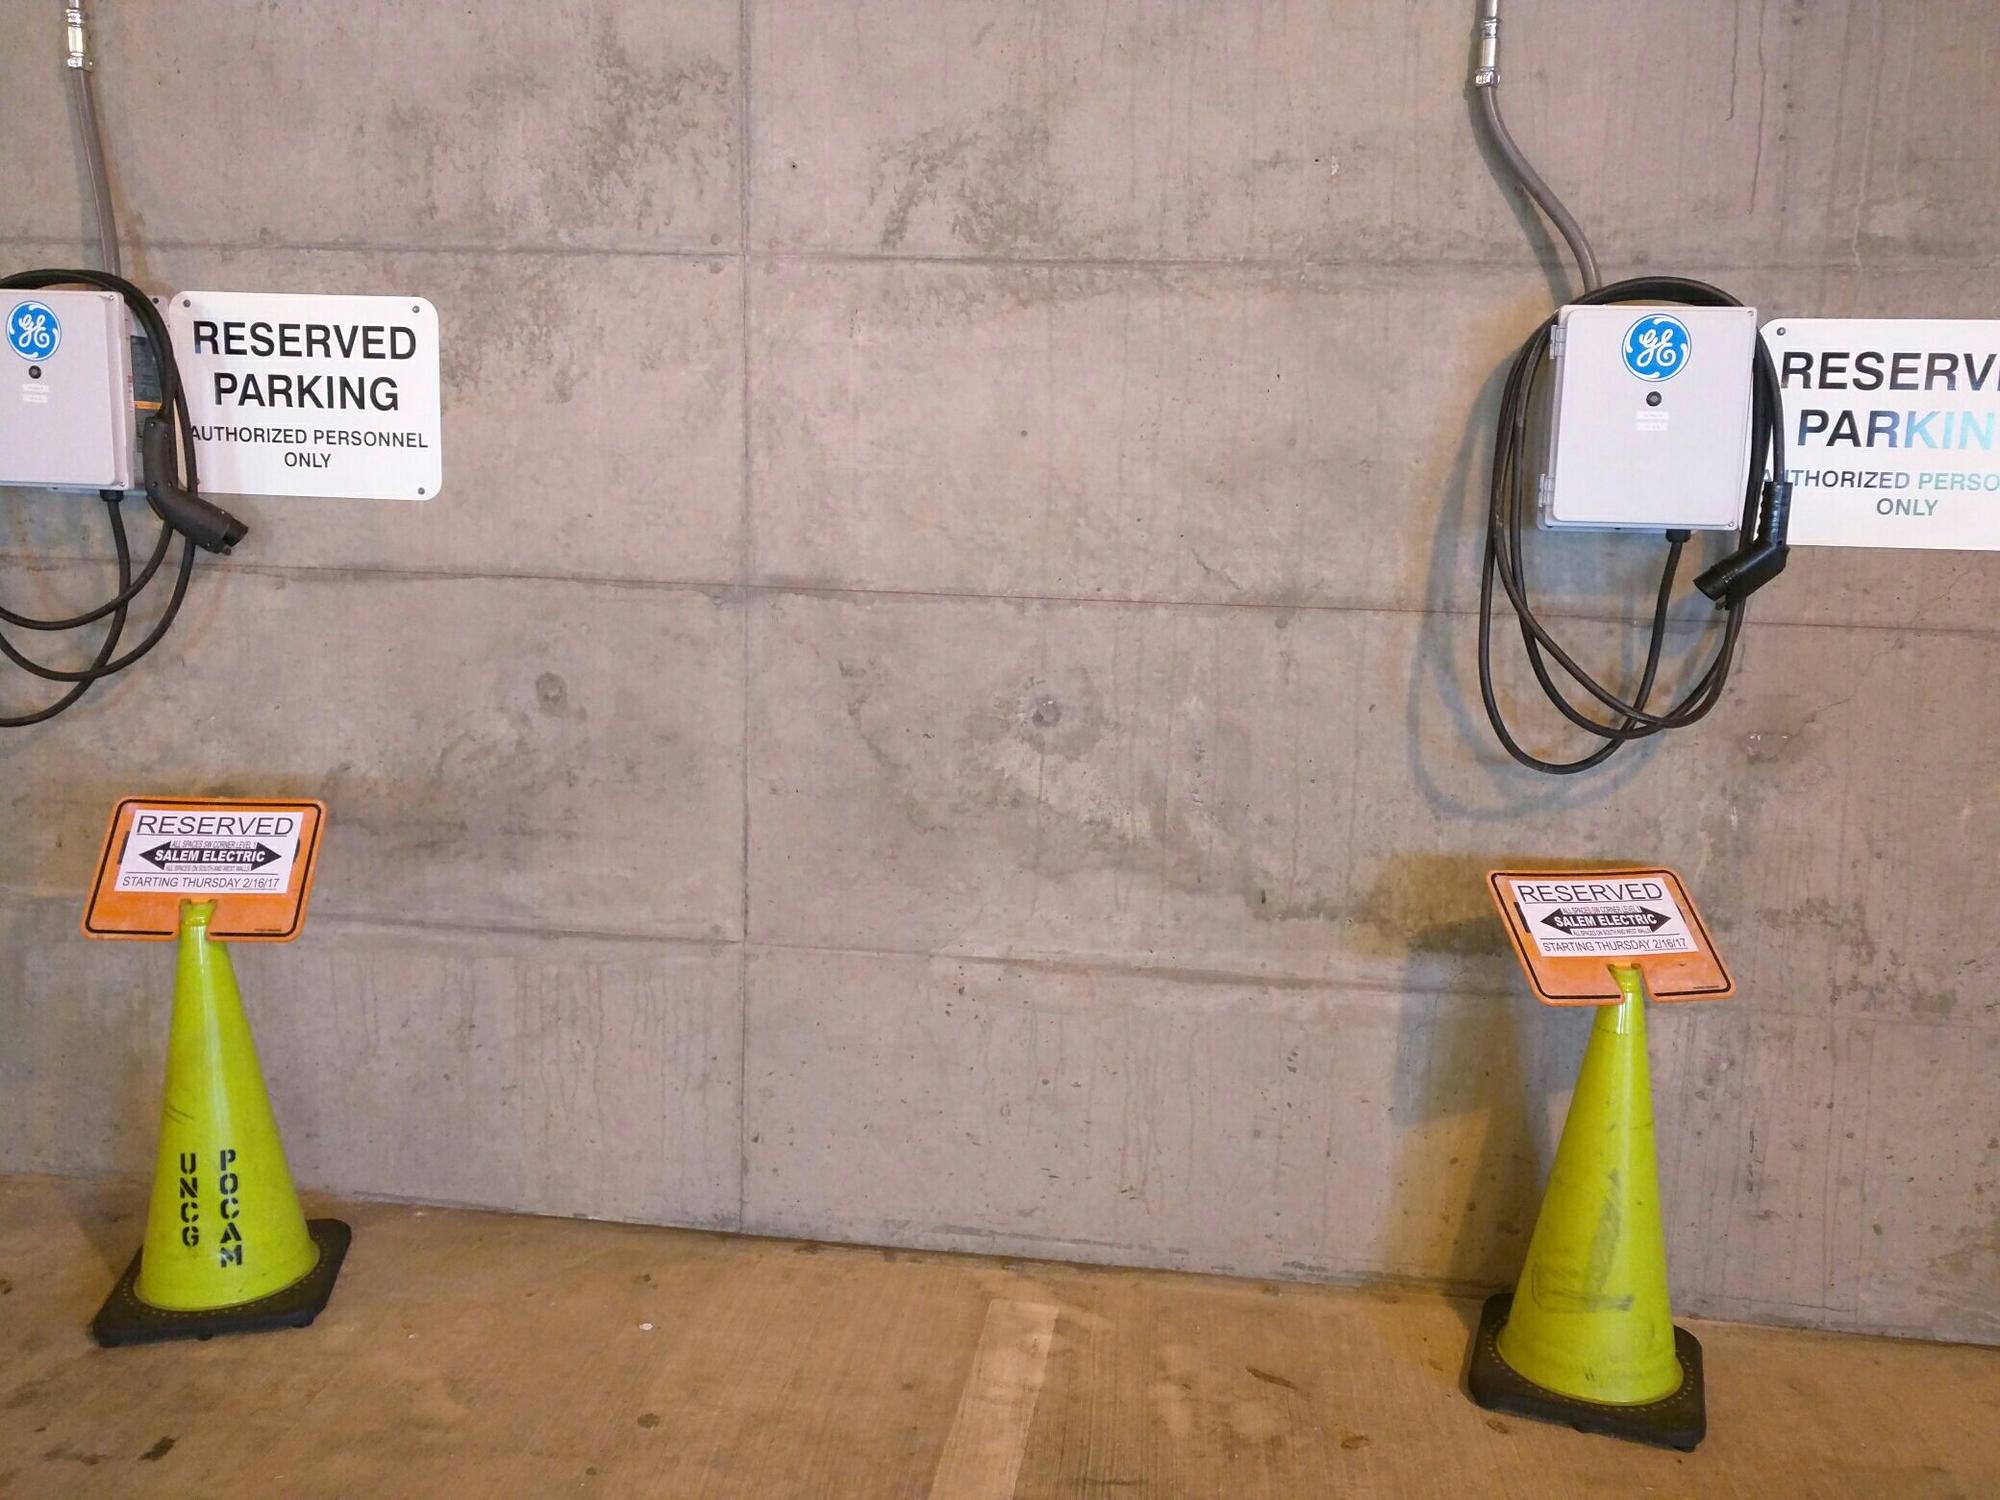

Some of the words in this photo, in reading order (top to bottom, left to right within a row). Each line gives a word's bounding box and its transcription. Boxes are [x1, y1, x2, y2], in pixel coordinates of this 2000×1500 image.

[193, 321, 417, 360] RESERVED
[1781, 351, 2000, 392] RESERV
[214, 372, 400, 411] PARKING
[189, 425, 308, 445] AUTHORIZED
[313, 430, 429, 449] PERSONNEL
[1797, 408, 1995, 450] PARKIN
[284, 452, 332, 469] ONLY
[1918, 472, 2000, 492] PERSO
[1876, 498, 1938, 517] ONLY
[136, 815, 294, 835] RESERVED
[171, 840, 181, 848] ALL
[182, 840, 204, 849] SPACES
[213, 841, 236, 850] CORNER
[235, 841, 252, 850] LEVEL
[155, 849, 201, 862] SALEM
[202, 851, 266, 863] ELECTRIC
[122, 876, 178, 887] STARTING
[181, 877, 241, 888] THURSDAY
[242, 878, 280, 889] 2/16/17
[1517, 882, 1663, 902] RESERVED
[1554, 915, 1597, 927] SALEM
[1597, 914, 1657, 926] ELECTRIC
[1542, 941, 1594, 952] STARTING
[1594, 939, 1651, 951] THURSDAY
[1651, 938, 1687, 949] 2/16/17
[179, 1152, 200, 1248] UNCG
